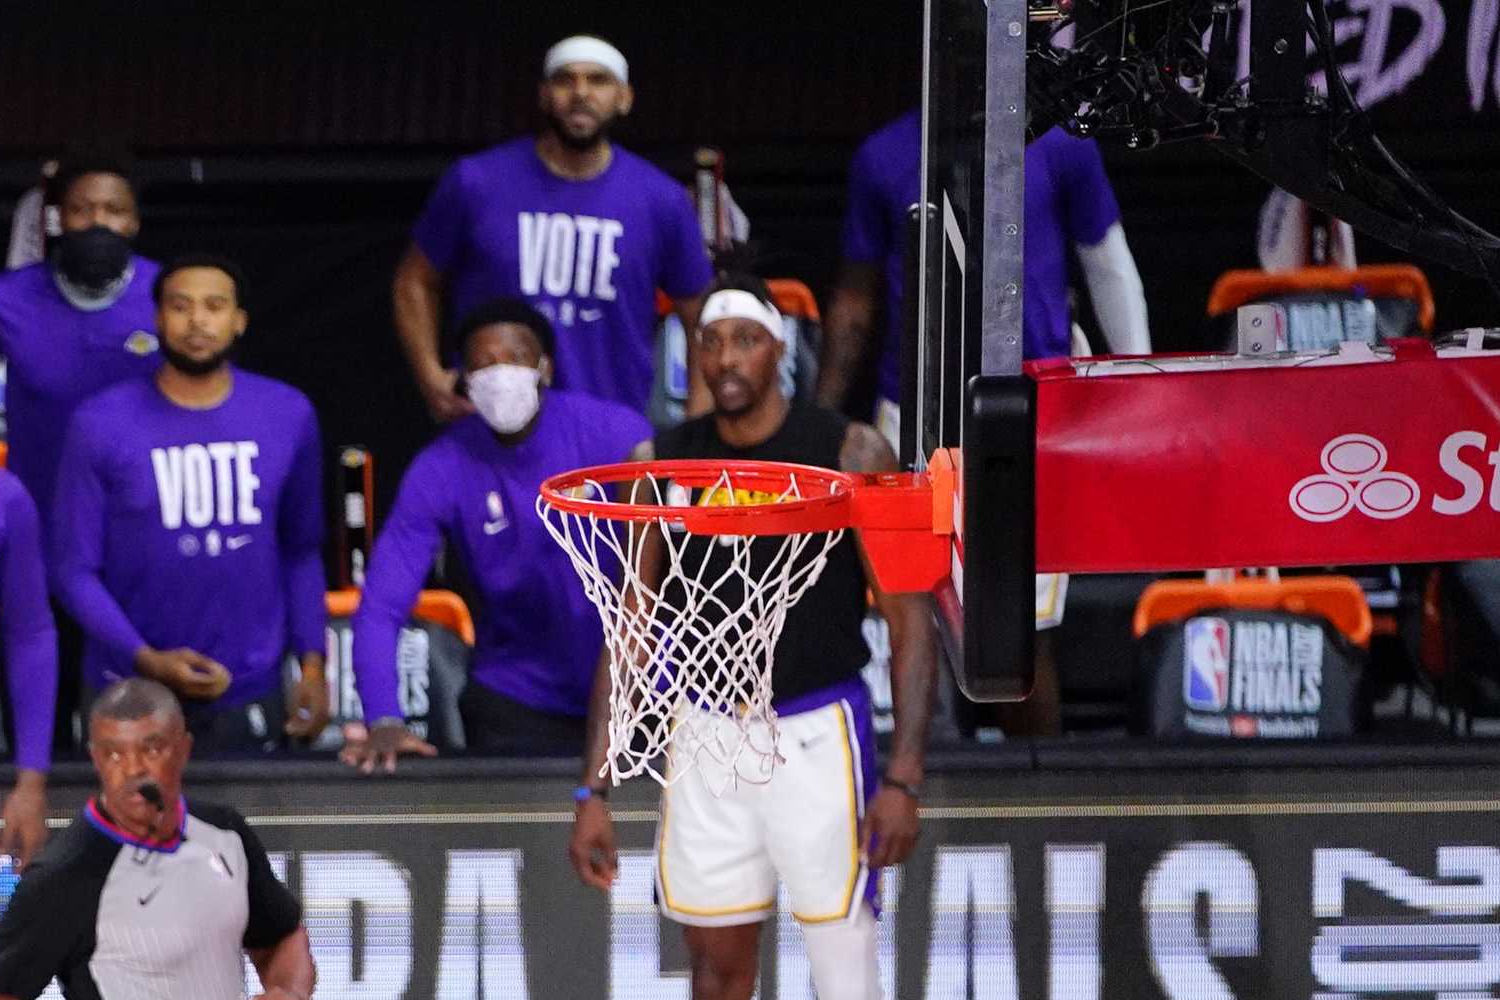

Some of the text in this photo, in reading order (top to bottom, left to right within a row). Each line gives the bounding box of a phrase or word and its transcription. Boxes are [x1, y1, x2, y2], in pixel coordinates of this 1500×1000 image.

[518, 211, 624, 301] VOTE
[150, 439, 262, 530] VOTE
[1233, 620, 1289, 667] NBA
[1231, 664, 1323, 714] FINALS
